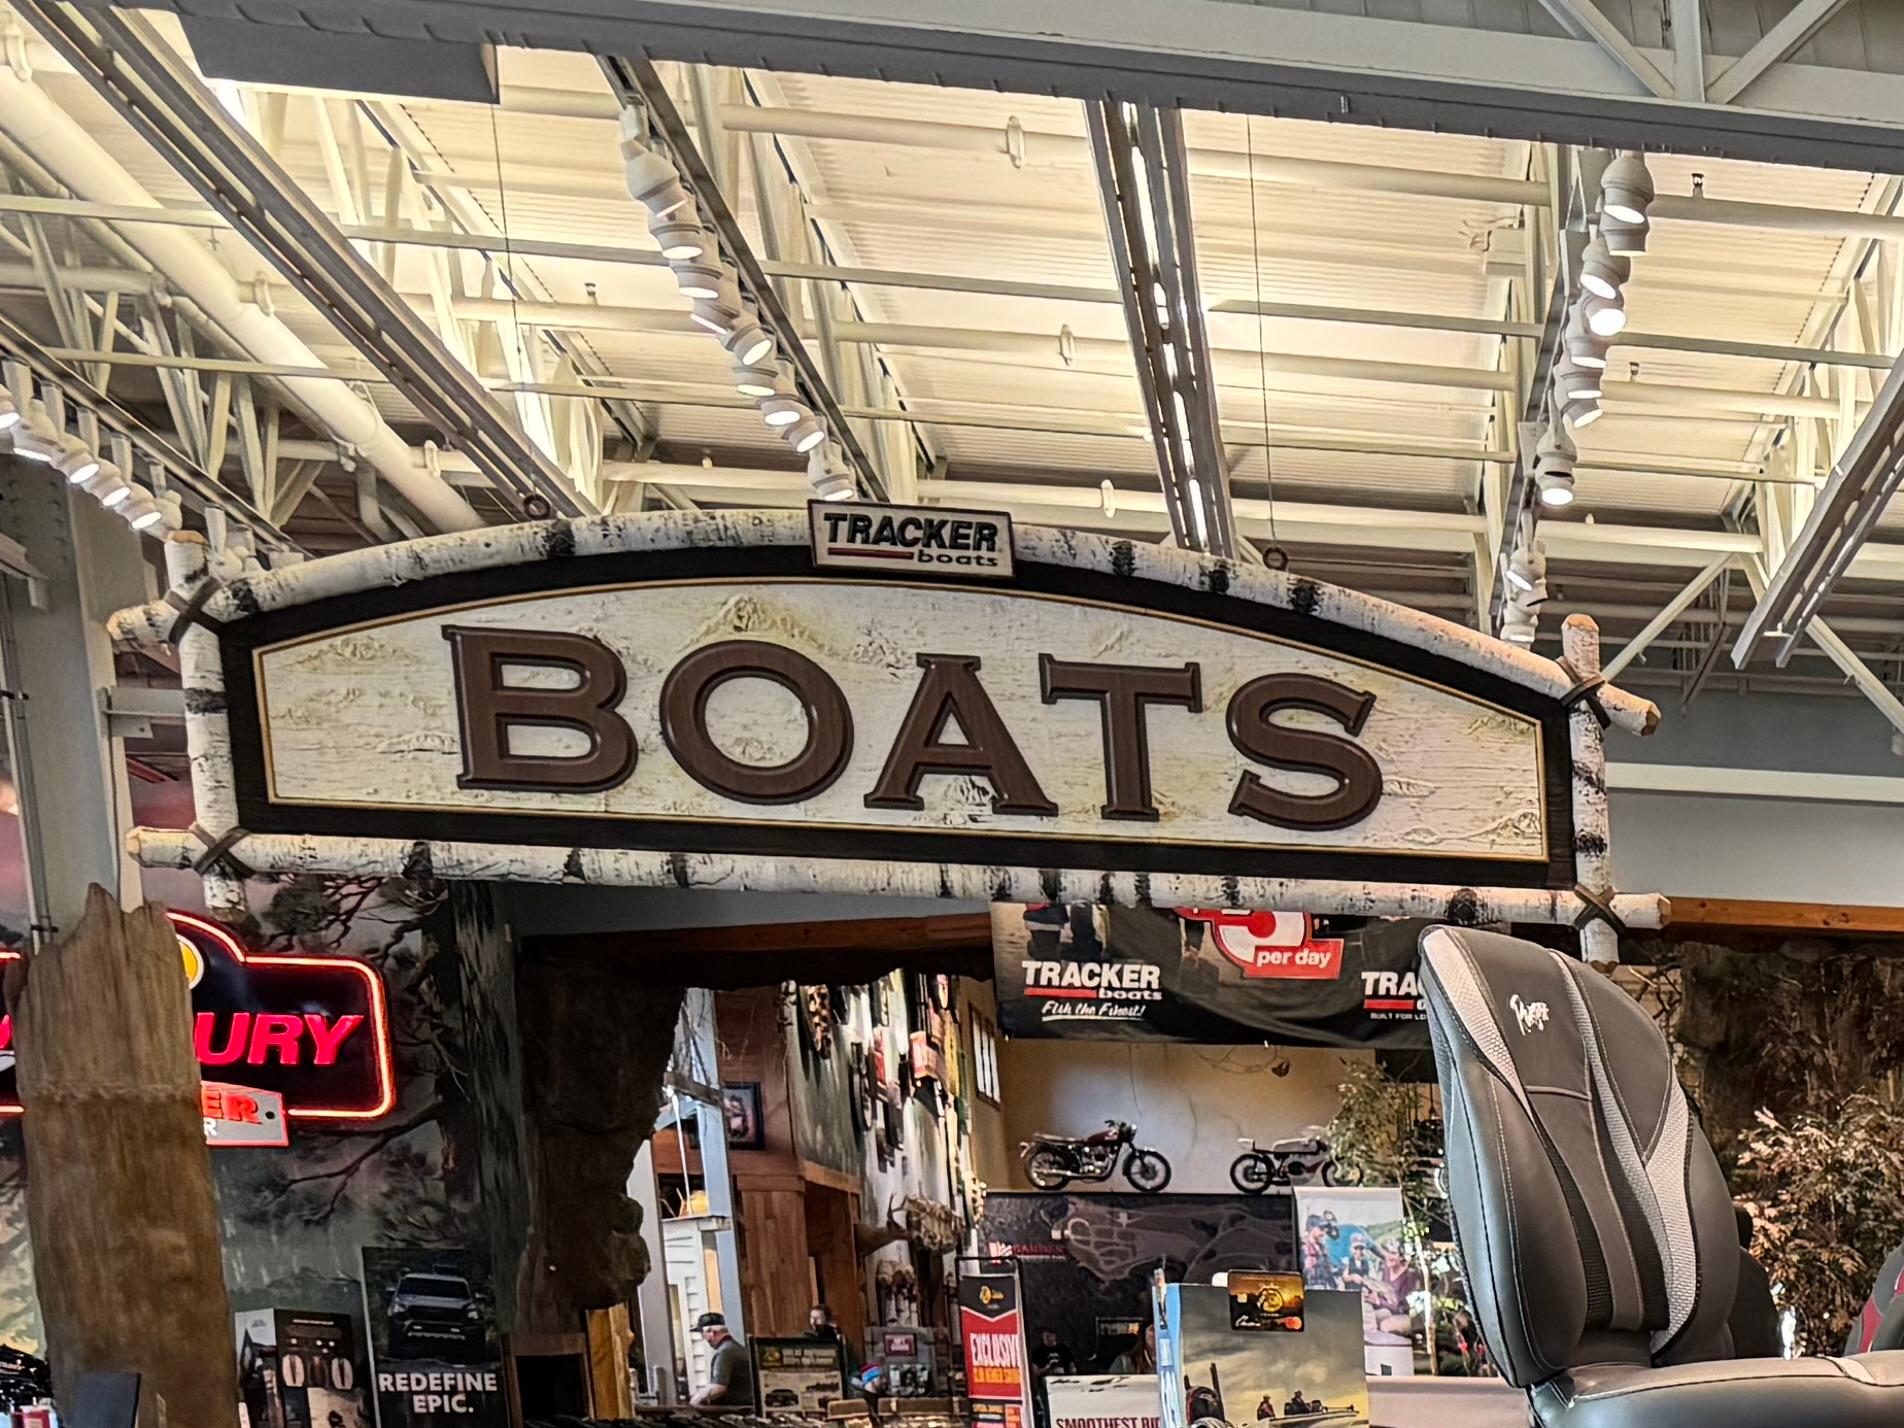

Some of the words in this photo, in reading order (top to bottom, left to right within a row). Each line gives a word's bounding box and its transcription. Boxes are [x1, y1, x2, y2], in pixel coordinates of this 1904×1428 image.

[824, 511, 998, 553] TRACKER
[917, 546, 999, 567] boats
[441, 624, 1384, 831] BOATS
[1257, 951, 1292, 968] per
[1295, 948, 1331, 968] day
[1021, 960, 1161, 990] TRACKER
[1361, 971, 1426, 997] TRA
[1098, 987, 1163, 1001] boats
[377, 1372, 498, 1392] REDEFINE
[412, 1394, 475, 1414] EPIC.
